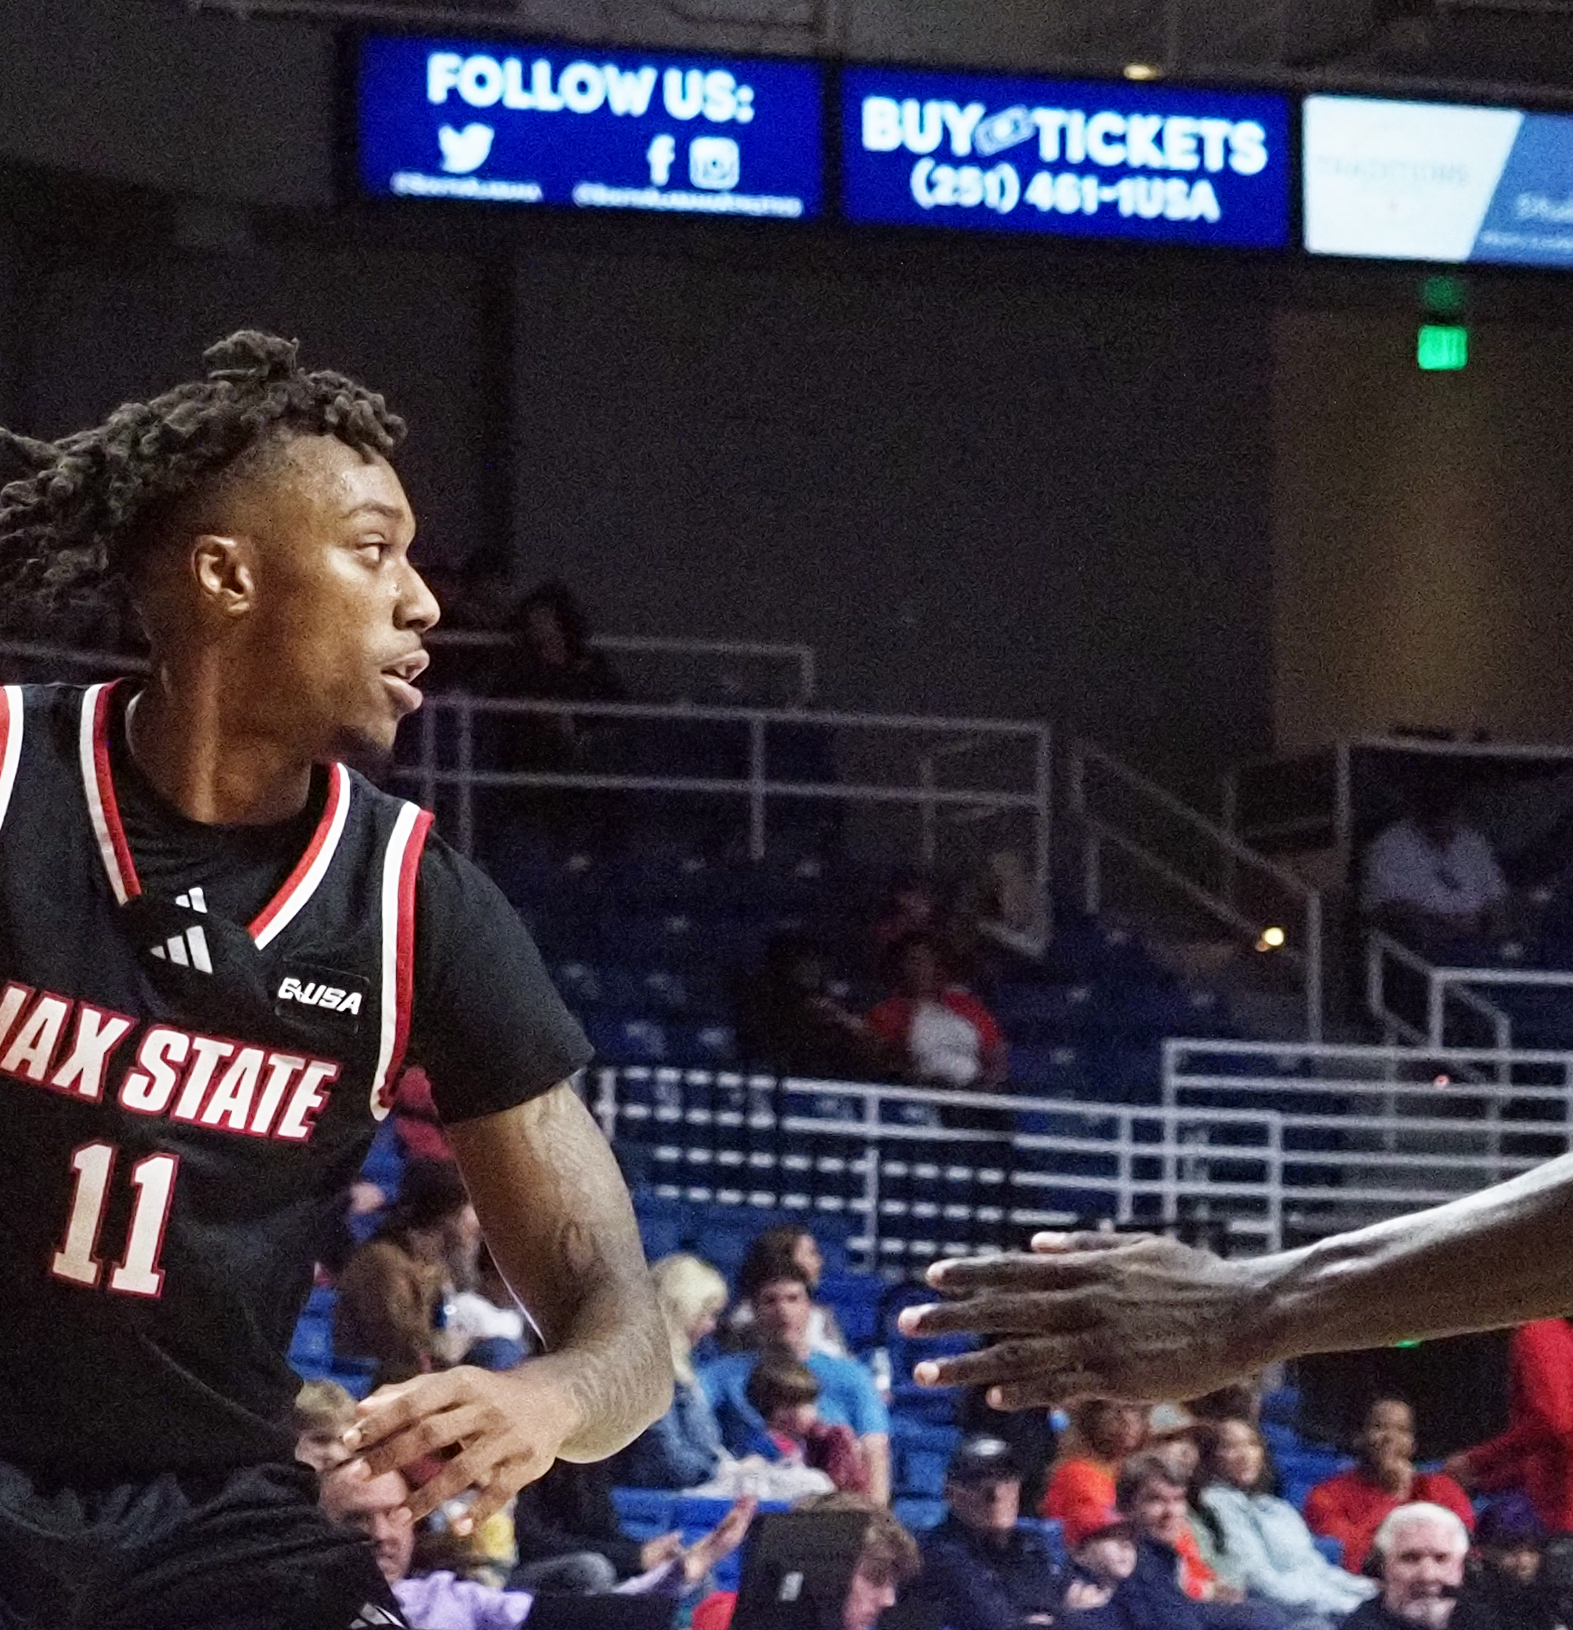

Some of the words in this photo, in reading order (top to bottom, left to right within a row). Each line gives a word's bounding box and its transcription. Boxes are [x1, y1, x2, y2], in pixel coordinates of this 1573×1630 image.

[427, 53, 656, 116] FOLLOW
[663, 68, 755, 123] US:
[861, 96, 984, 156] BUY
[1030, 107, 1268, 174] TICKETS
[118, 1023, 344, 1142] STATE
[50, 1139, 181, 1298] 11
